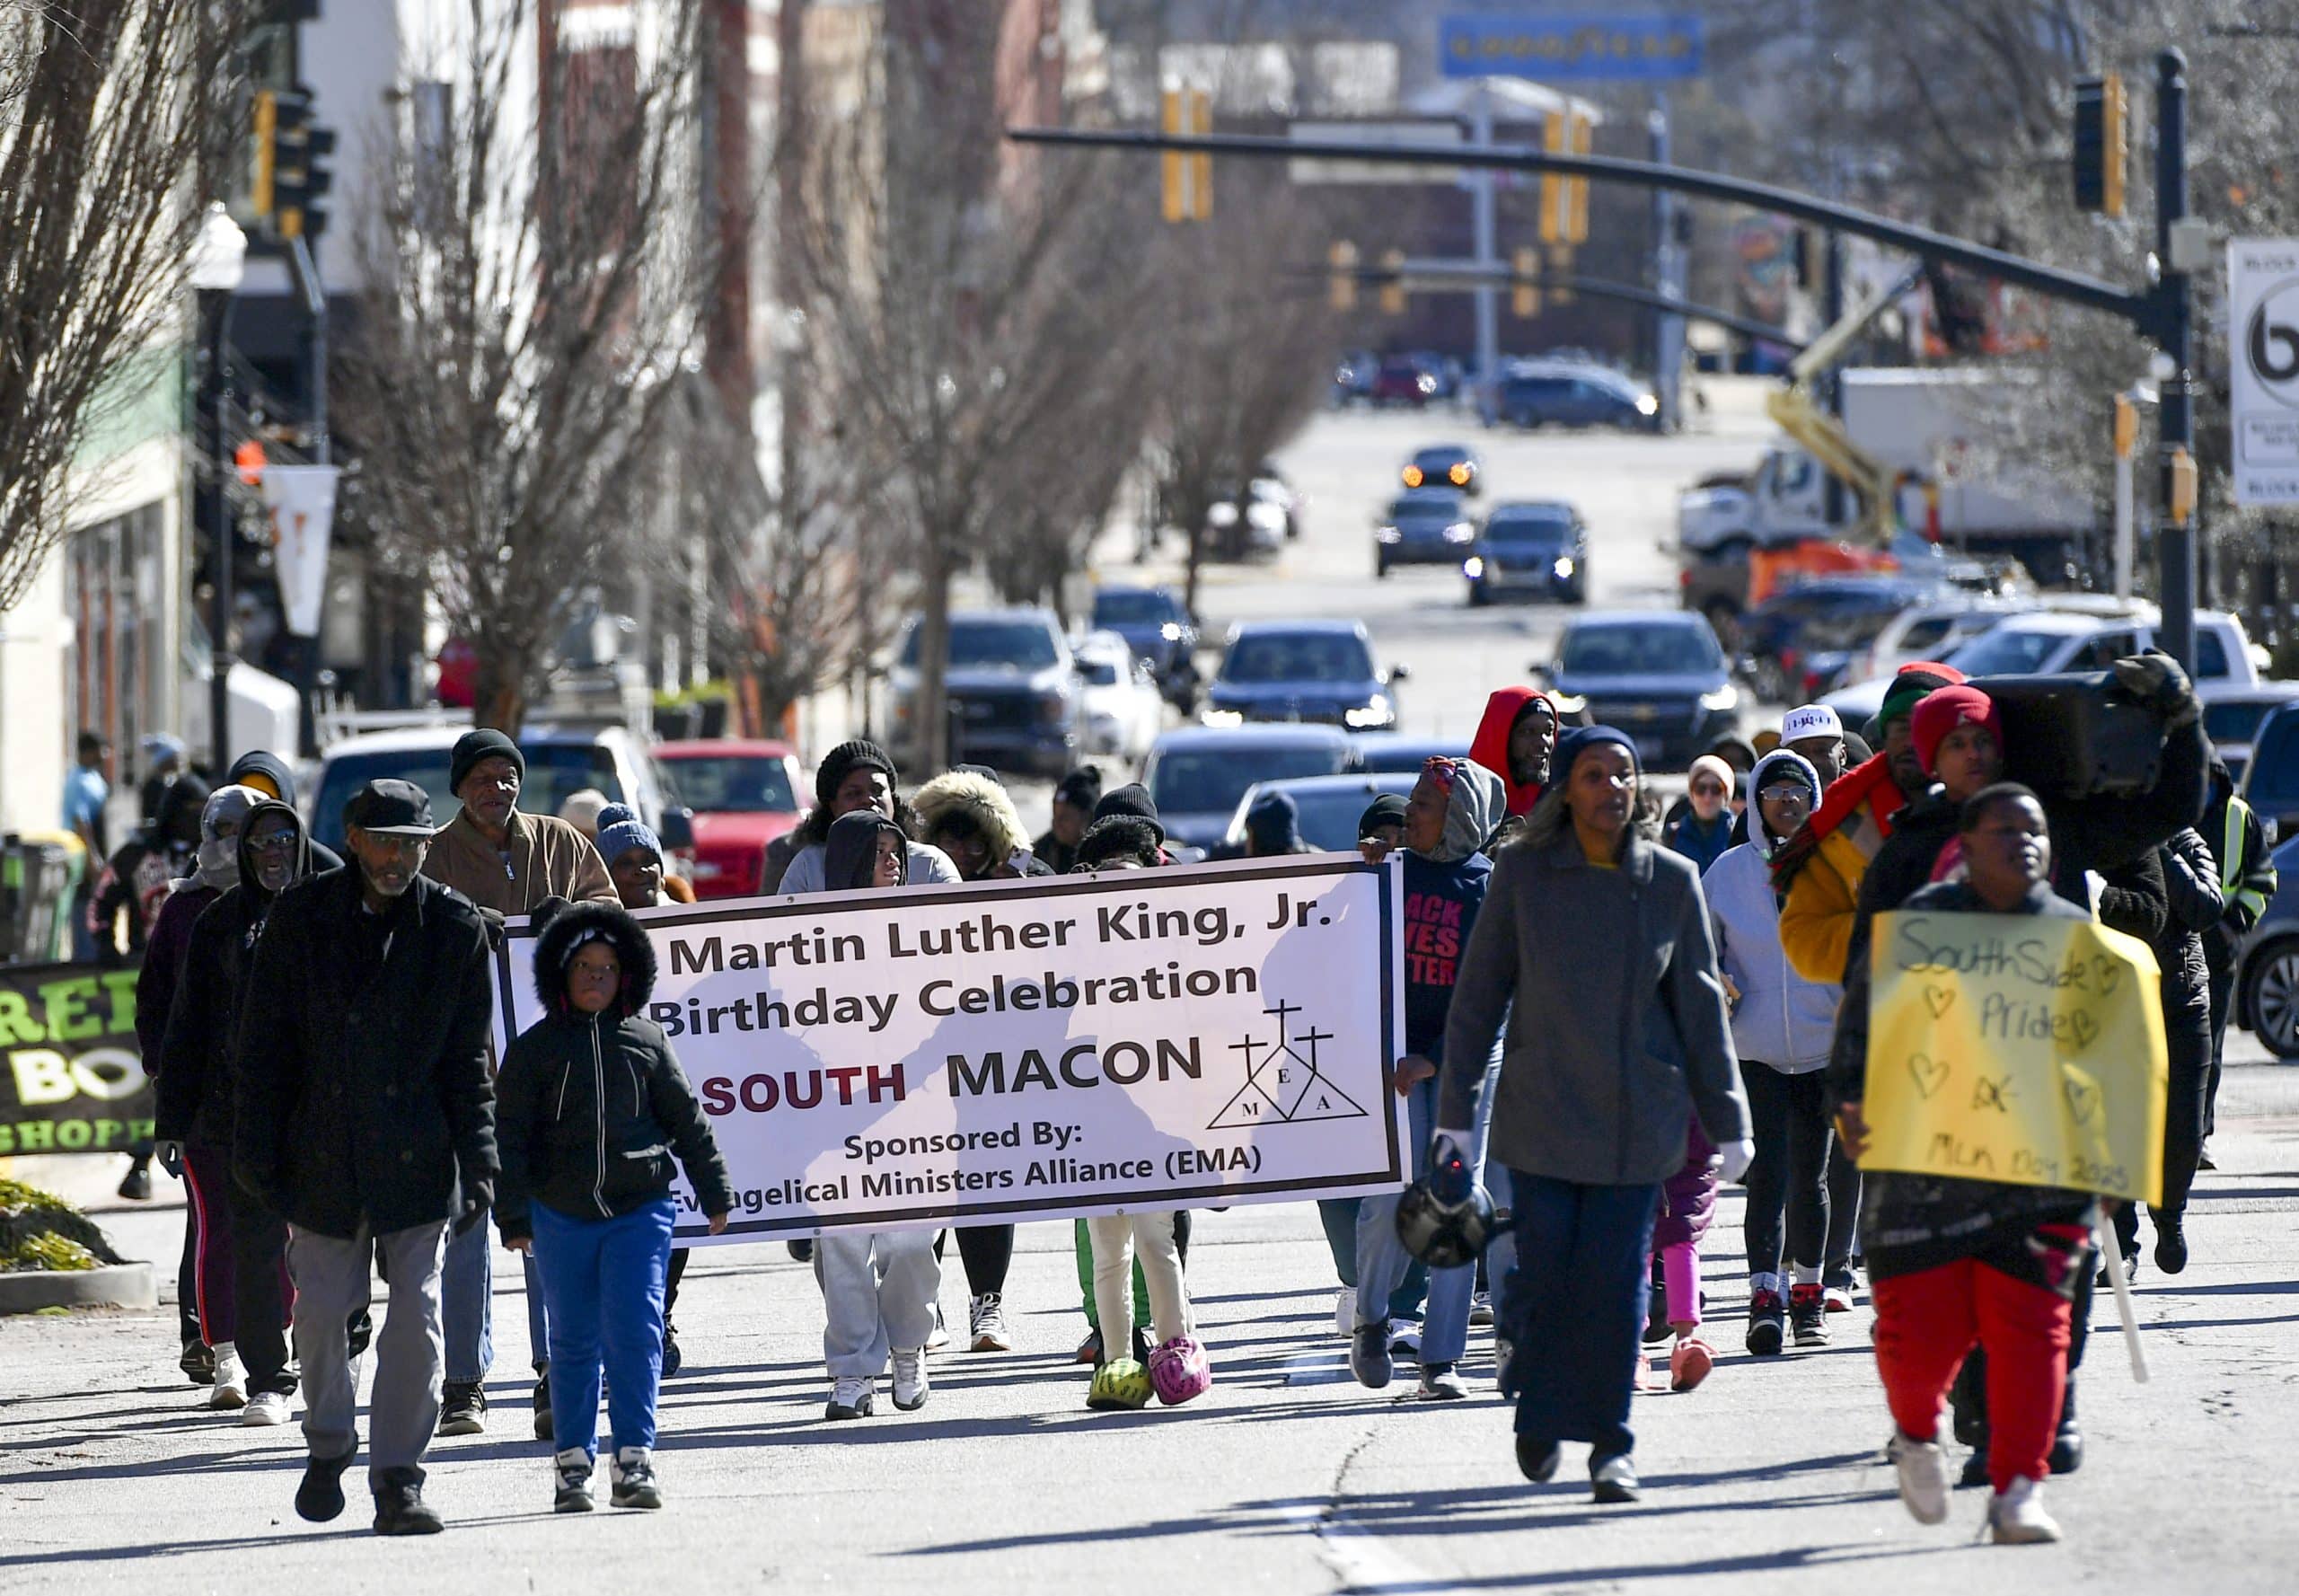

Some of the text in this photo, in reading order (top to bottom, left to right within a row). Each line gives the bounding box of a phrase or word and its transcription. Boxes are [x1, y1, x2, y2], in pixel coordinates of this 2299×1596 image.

[670, 893, 1331, 975] Martin Luther King, Jr.
[649, 961, 1257, 1037] Birthday Celebration
[1980, 991, 2069, 1043] Pride
[701, 1036, 1202, 1115] SOUTH MACON
[1277, 1069, 1290, 1083] E
[1242, 1102, 1259, 1116] M
[1317, 1095, 1330, 1109] A
[844, 1121, 1083, 1165] Sponsored By:
[670, 1146, 1263, 1214] Evgelical Ministers Alliance (EMA)
